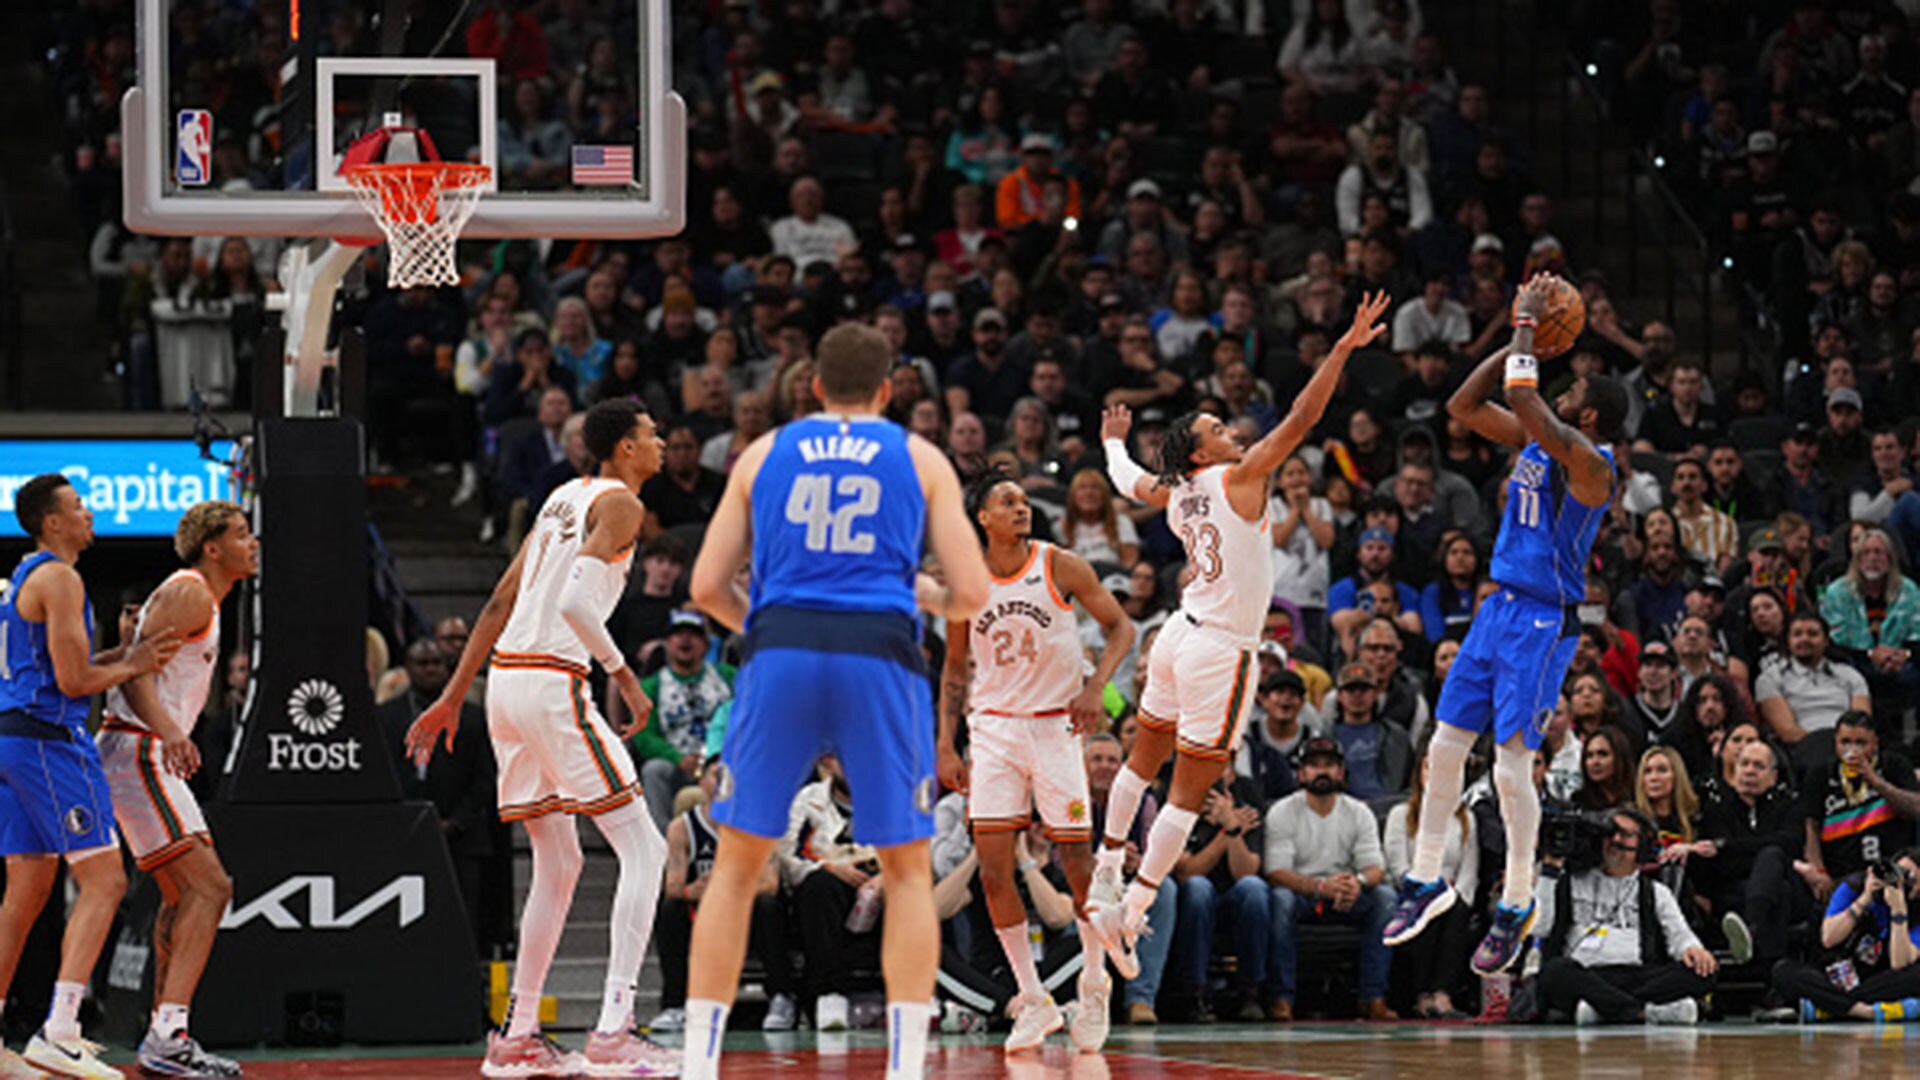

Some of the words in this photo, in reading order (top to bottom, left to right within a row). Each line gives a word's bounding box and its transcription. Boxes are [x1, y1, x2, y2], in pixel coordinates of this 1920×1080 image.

[785, 473, 882, 555] 42
[1518, 487, 1540, 528] 11
[991, 627, 1038, 667] 24
[267, 733, 361, 770] Frost
